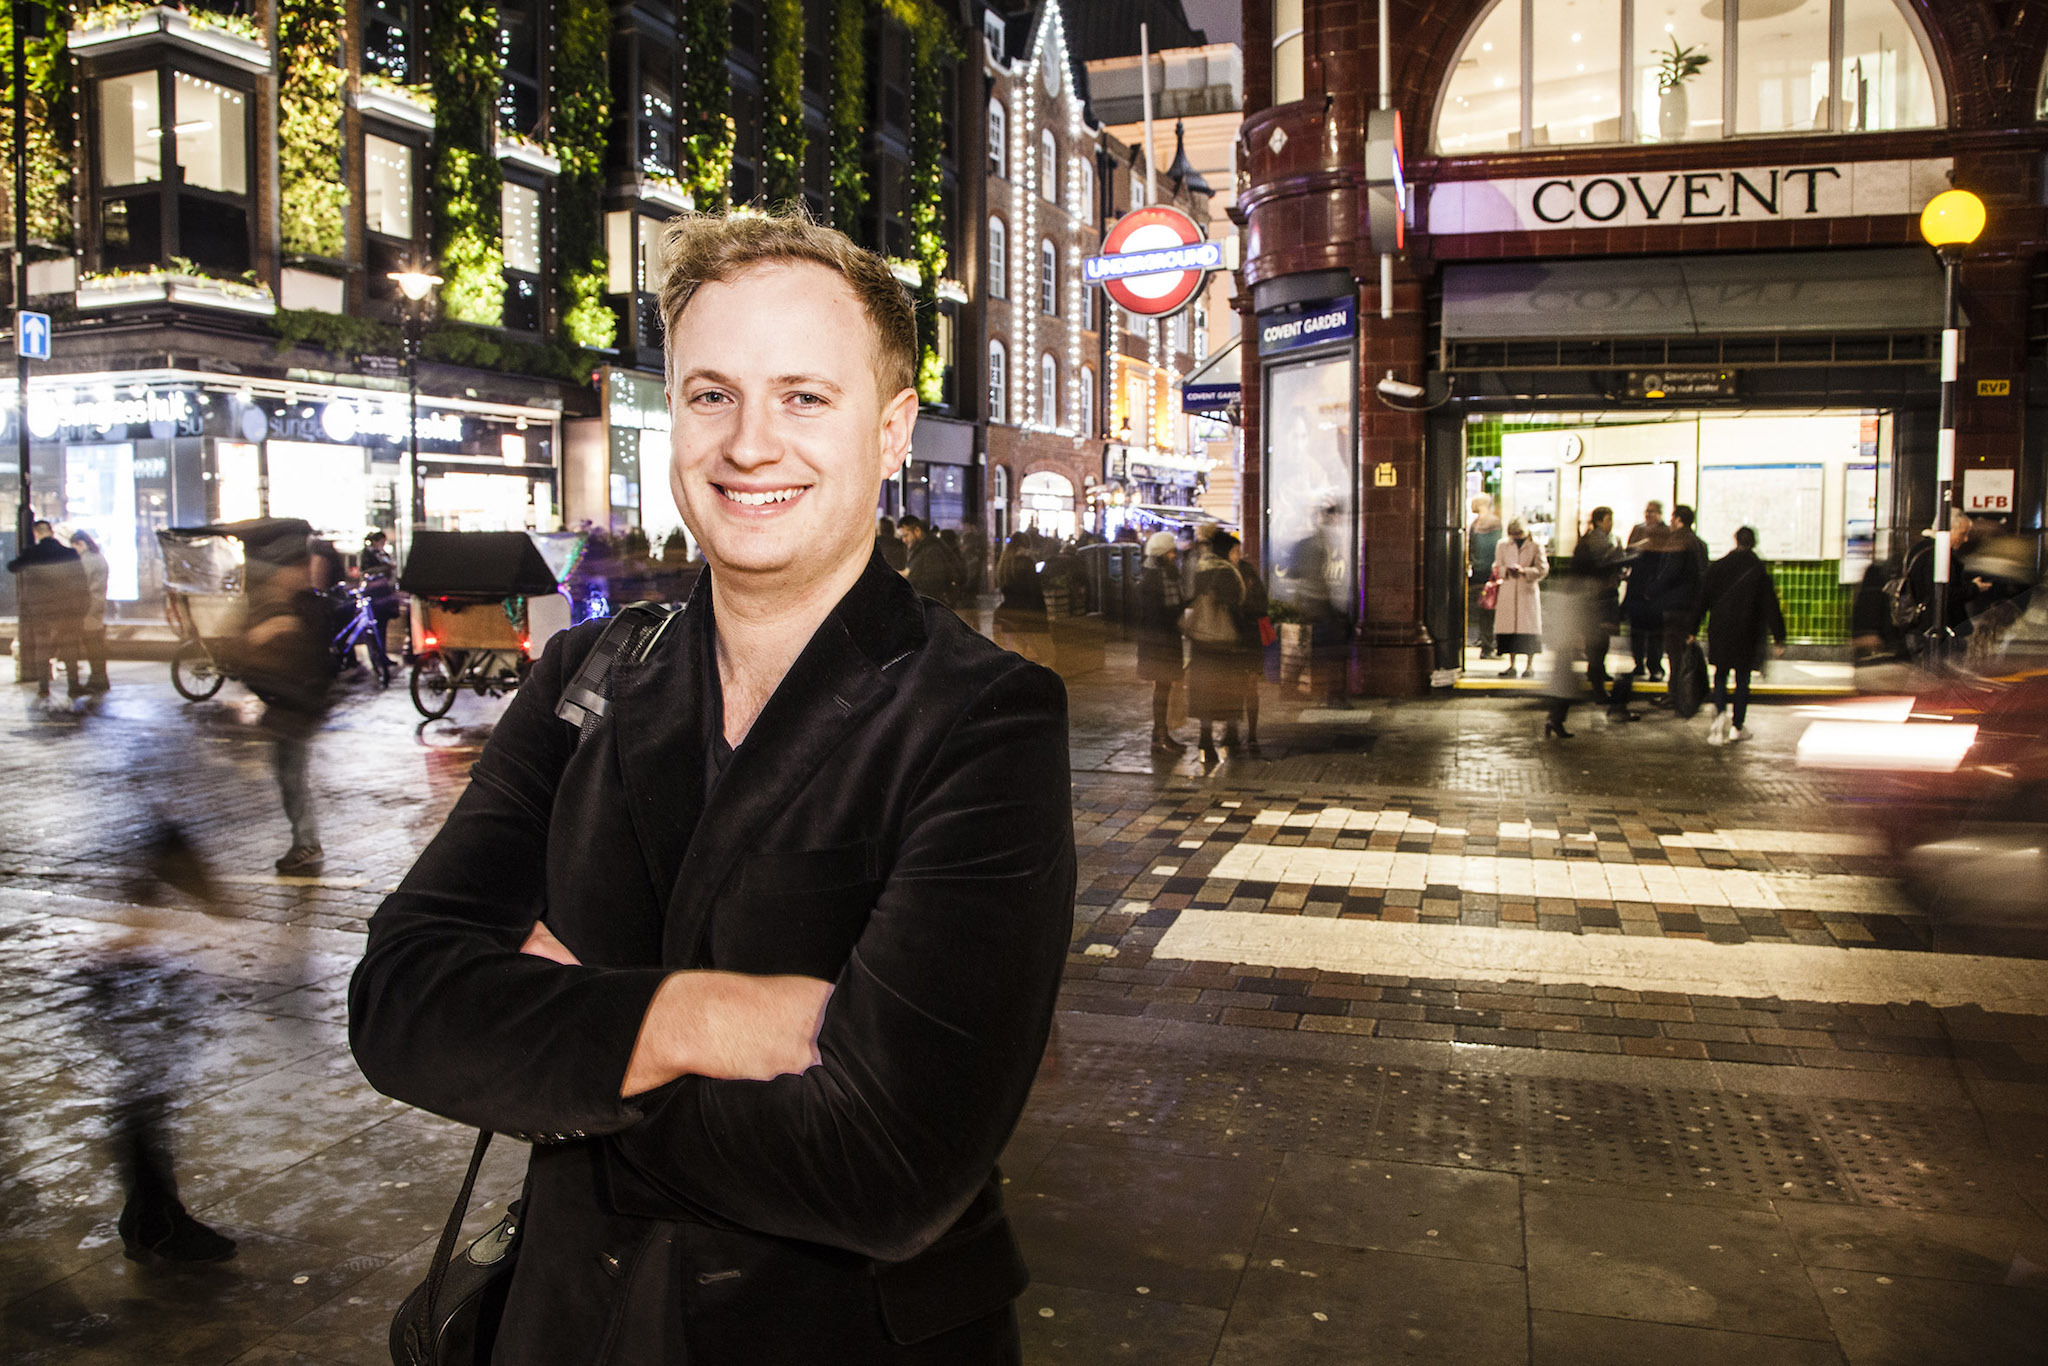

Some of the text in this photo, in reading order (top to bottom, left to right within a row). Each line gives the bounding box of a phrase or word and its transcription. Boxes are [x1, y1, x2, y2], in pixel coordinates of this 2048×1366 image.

[1532, 166, 1841, 223] COVENT
[1087, 244, 1219, 278] UNDERGROUND
[1263, 310, 1347, 342] COVENT GARDEN
[1186, 392, 1215, 402] COVENT
[1980, 382, 2007, 393] RVP
[147, 389, 187, 423] hut
[1972, 496, 2008, 508] LFB
